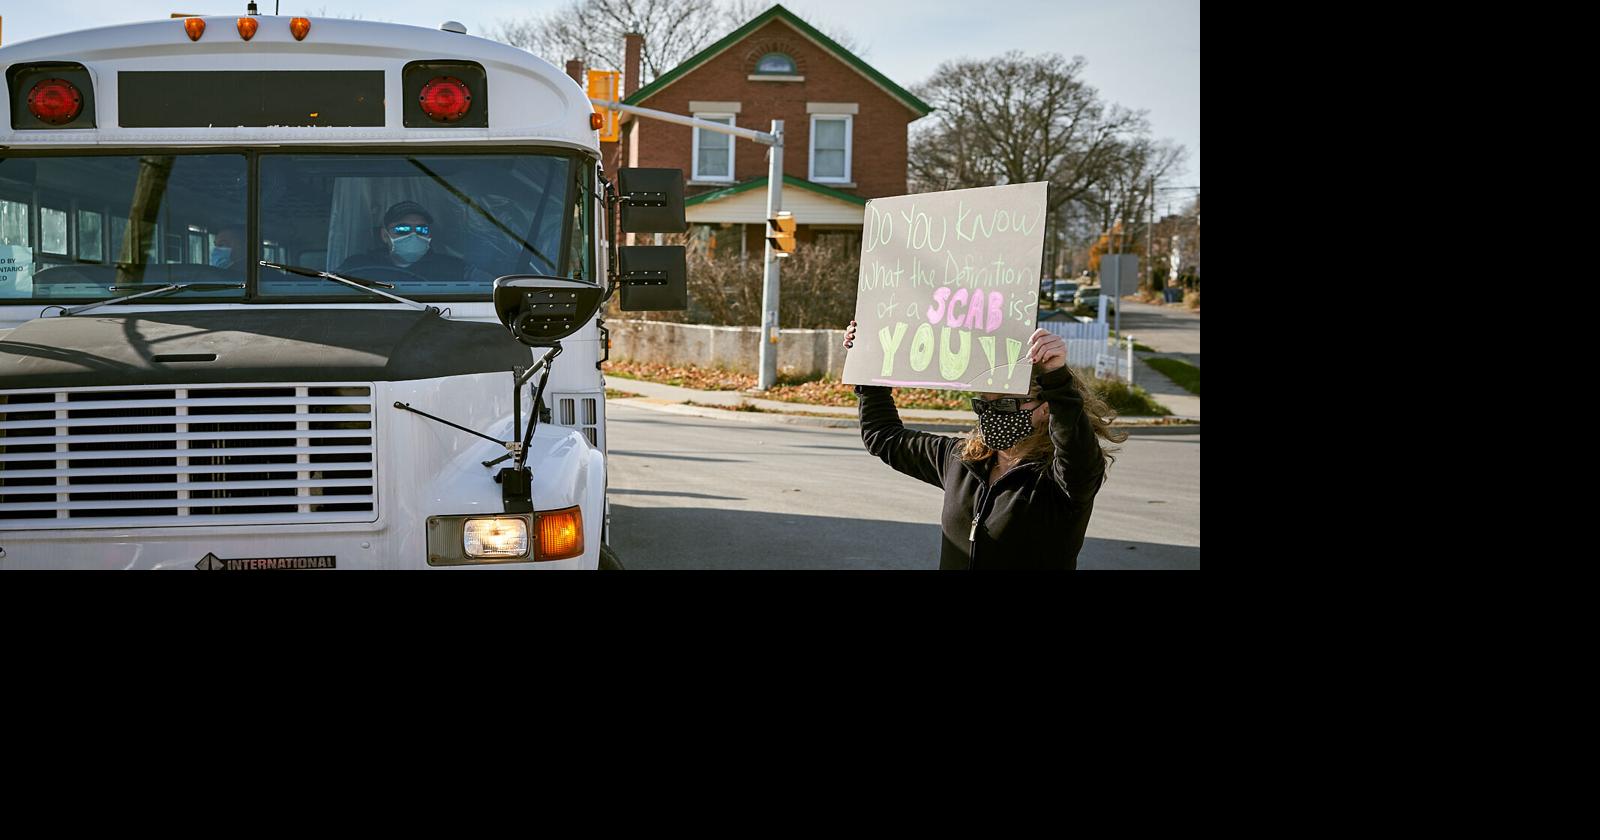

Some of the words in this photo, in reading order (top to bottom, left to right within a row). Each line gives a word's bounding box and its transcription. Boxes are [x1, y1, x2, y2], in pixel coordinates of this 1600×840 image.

[866, 204, 893, 253] DO
[901, 203, 947, 253] YOU
[911, 255, 935, 288] the
[906, 302, 921, 320] a
[927, 286, 1004, 333] SCAB
[1008, 290, 1038, 327] is?
[227, 557, 333, 570] INTERNATIONAL
